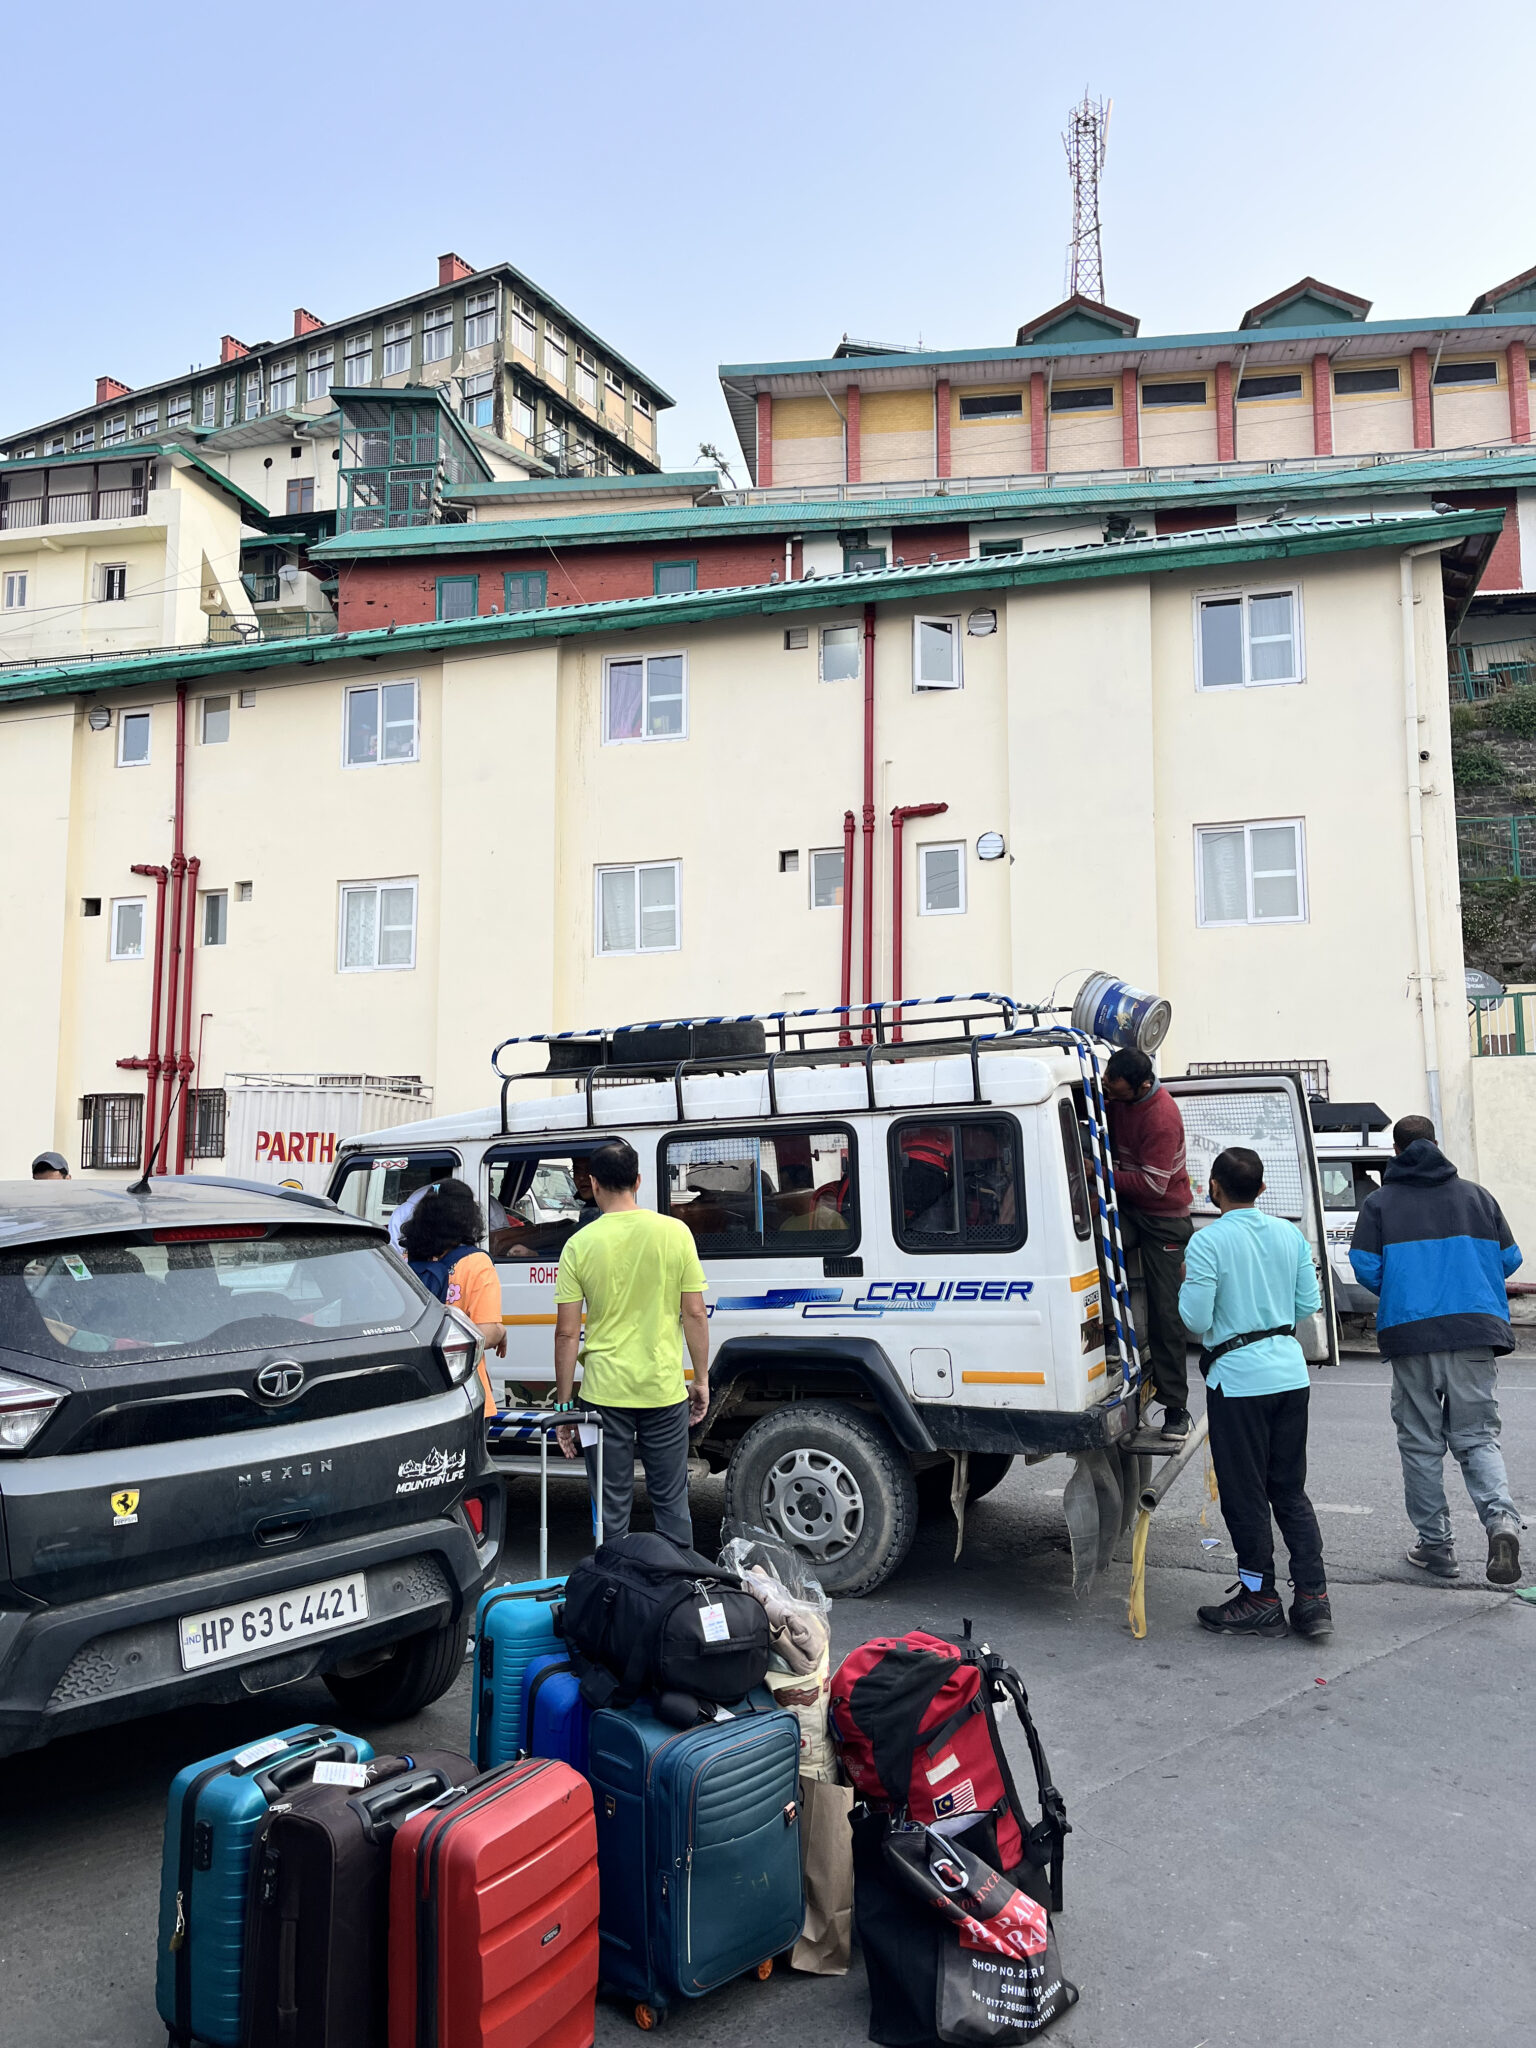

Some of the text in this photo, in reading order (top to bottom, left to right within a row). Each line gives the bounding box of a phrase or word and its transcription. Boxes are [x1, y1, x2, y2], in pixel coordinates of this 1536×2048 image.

[255, 1130, 337, 1164] PARTH
[866, 1281, 1034, 1301] CRUISER
[238, 1459, 333, 1488] NEXON
[396, 1469, 466, 1494] MOUNTAIN LIFE
[201, 1617, 234, 1654] HP
[242, 1607, 273, 1642] 63
[279, 1602, 293, 1631] C
[300, 1583, 357, 1625] 4421
[972, 1958, 997, 1973] SHOP
[999, 1966, 1016, 1978] NO.
